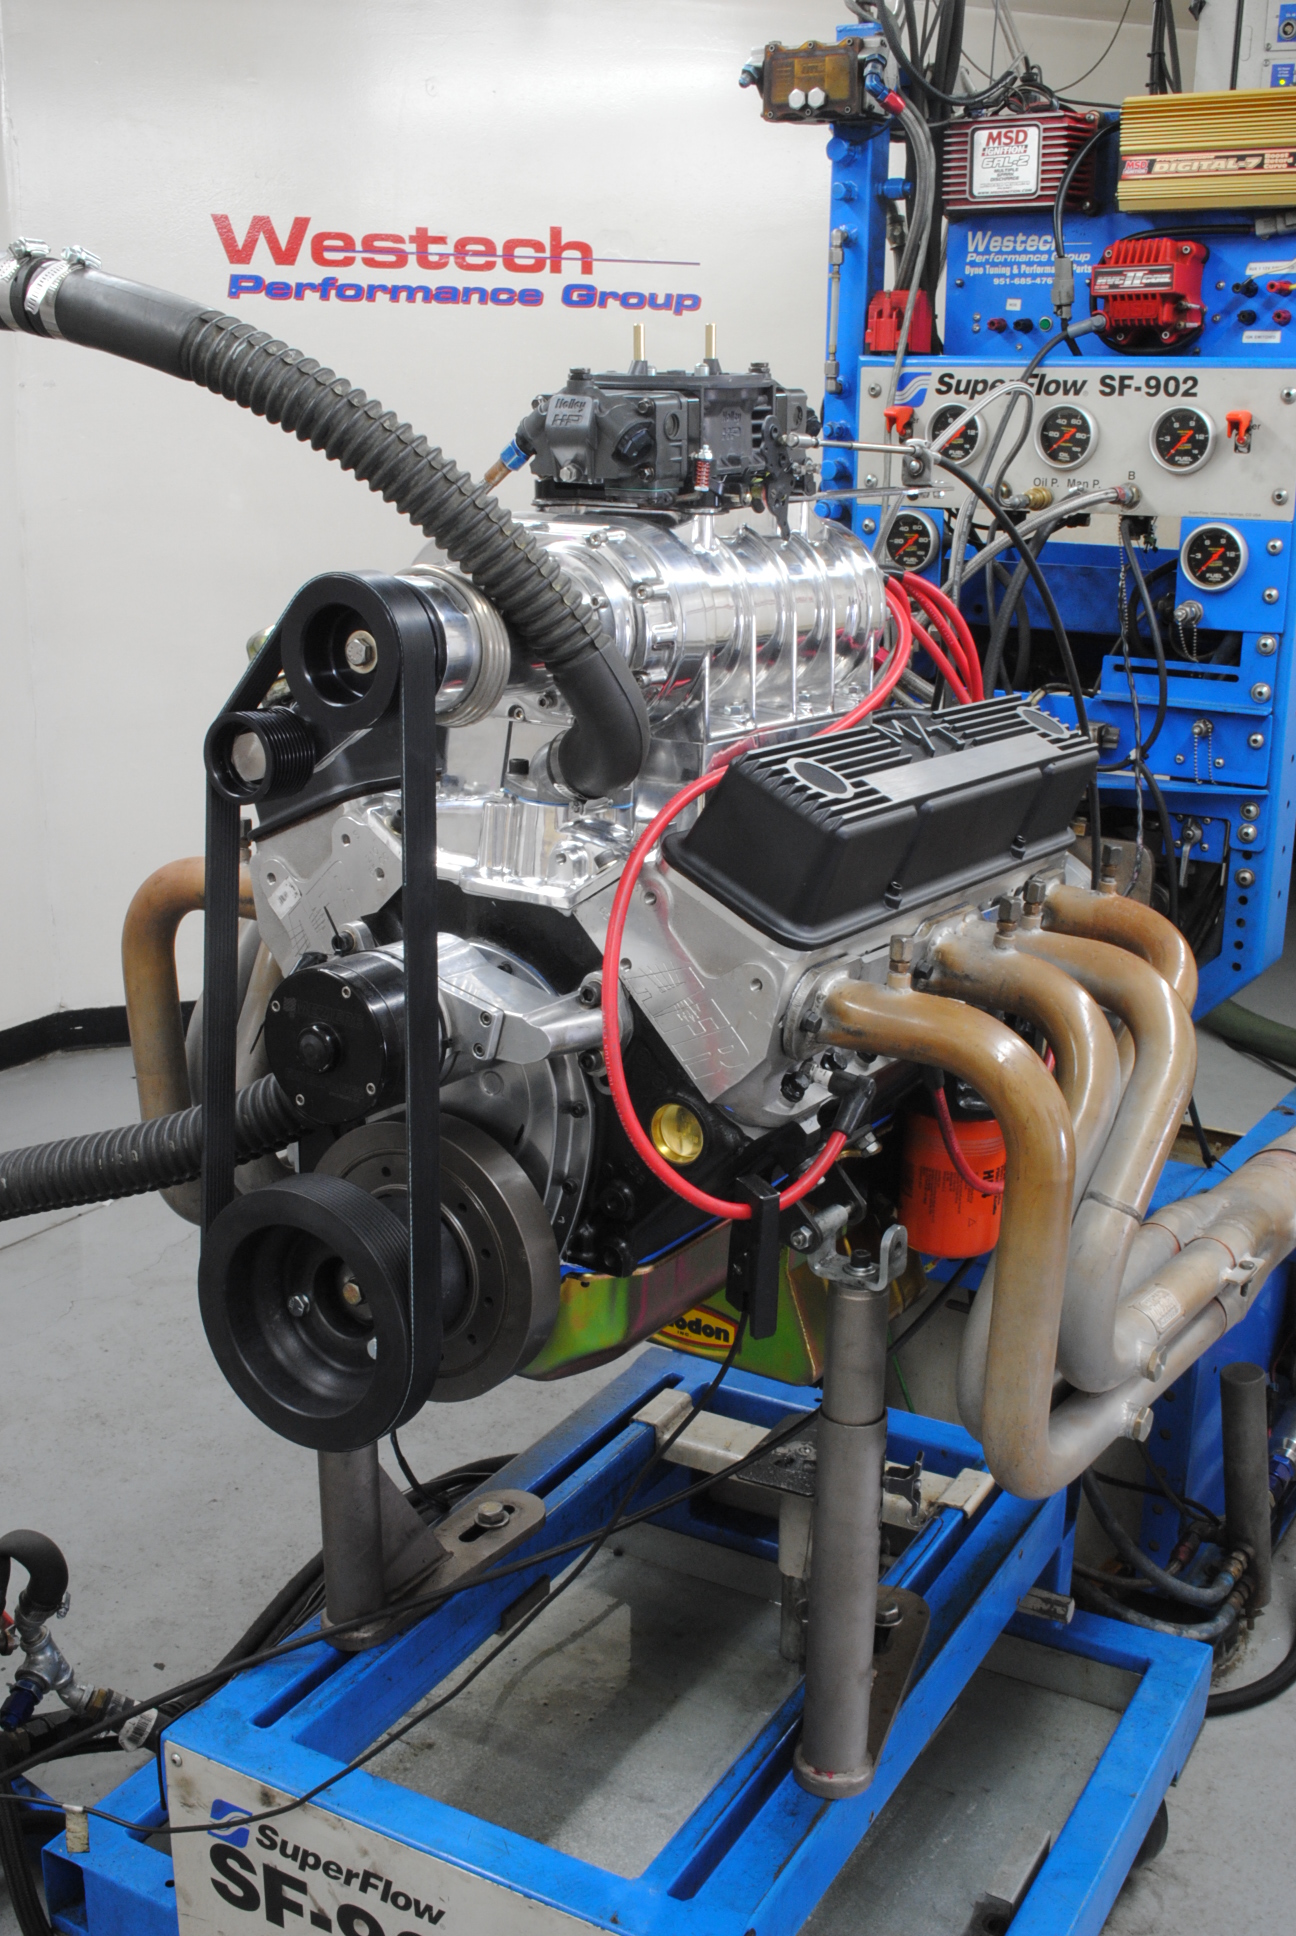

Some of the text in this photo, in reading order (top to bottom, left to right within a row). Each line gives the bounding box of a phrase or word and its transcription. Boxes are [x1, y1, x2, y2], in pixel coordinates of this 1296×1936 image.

[986, 129, 1028, 146] MSD
[983, 145, 1027, 156] IGNITION
[981, 155, 1030, 169] 6AL-2
[1126, 160, 1149, 169] MSD
[1151, 157, 1263, 174] DIGITAL-7
[211, 214, 593, 275] Westech
[966, 253, 1049, 263] Performance
[965, 265, 984, 276] Dyno
[985, 265, 1011, 276] Tuning
[1012, 265, 1019, 274] &
[1021, 265, 1056, 274] Performa
[993, 277, 1055, 285] 951-685-476
[228, 273, 702, 316] Performance Group
[1098, 374, 1199, 398] SF-902
[555, 398, 587, 413] Holley
[551, 413, 584, 427] HP
[1127, 470, 1136, 480] B
[1033, 477, 1060, 488] Oil P.
[1092, 479, 1101, 489] P.
[666, 1316, 730, 1344] odon
[255, 1824, 446, 1926] SuperFlow
